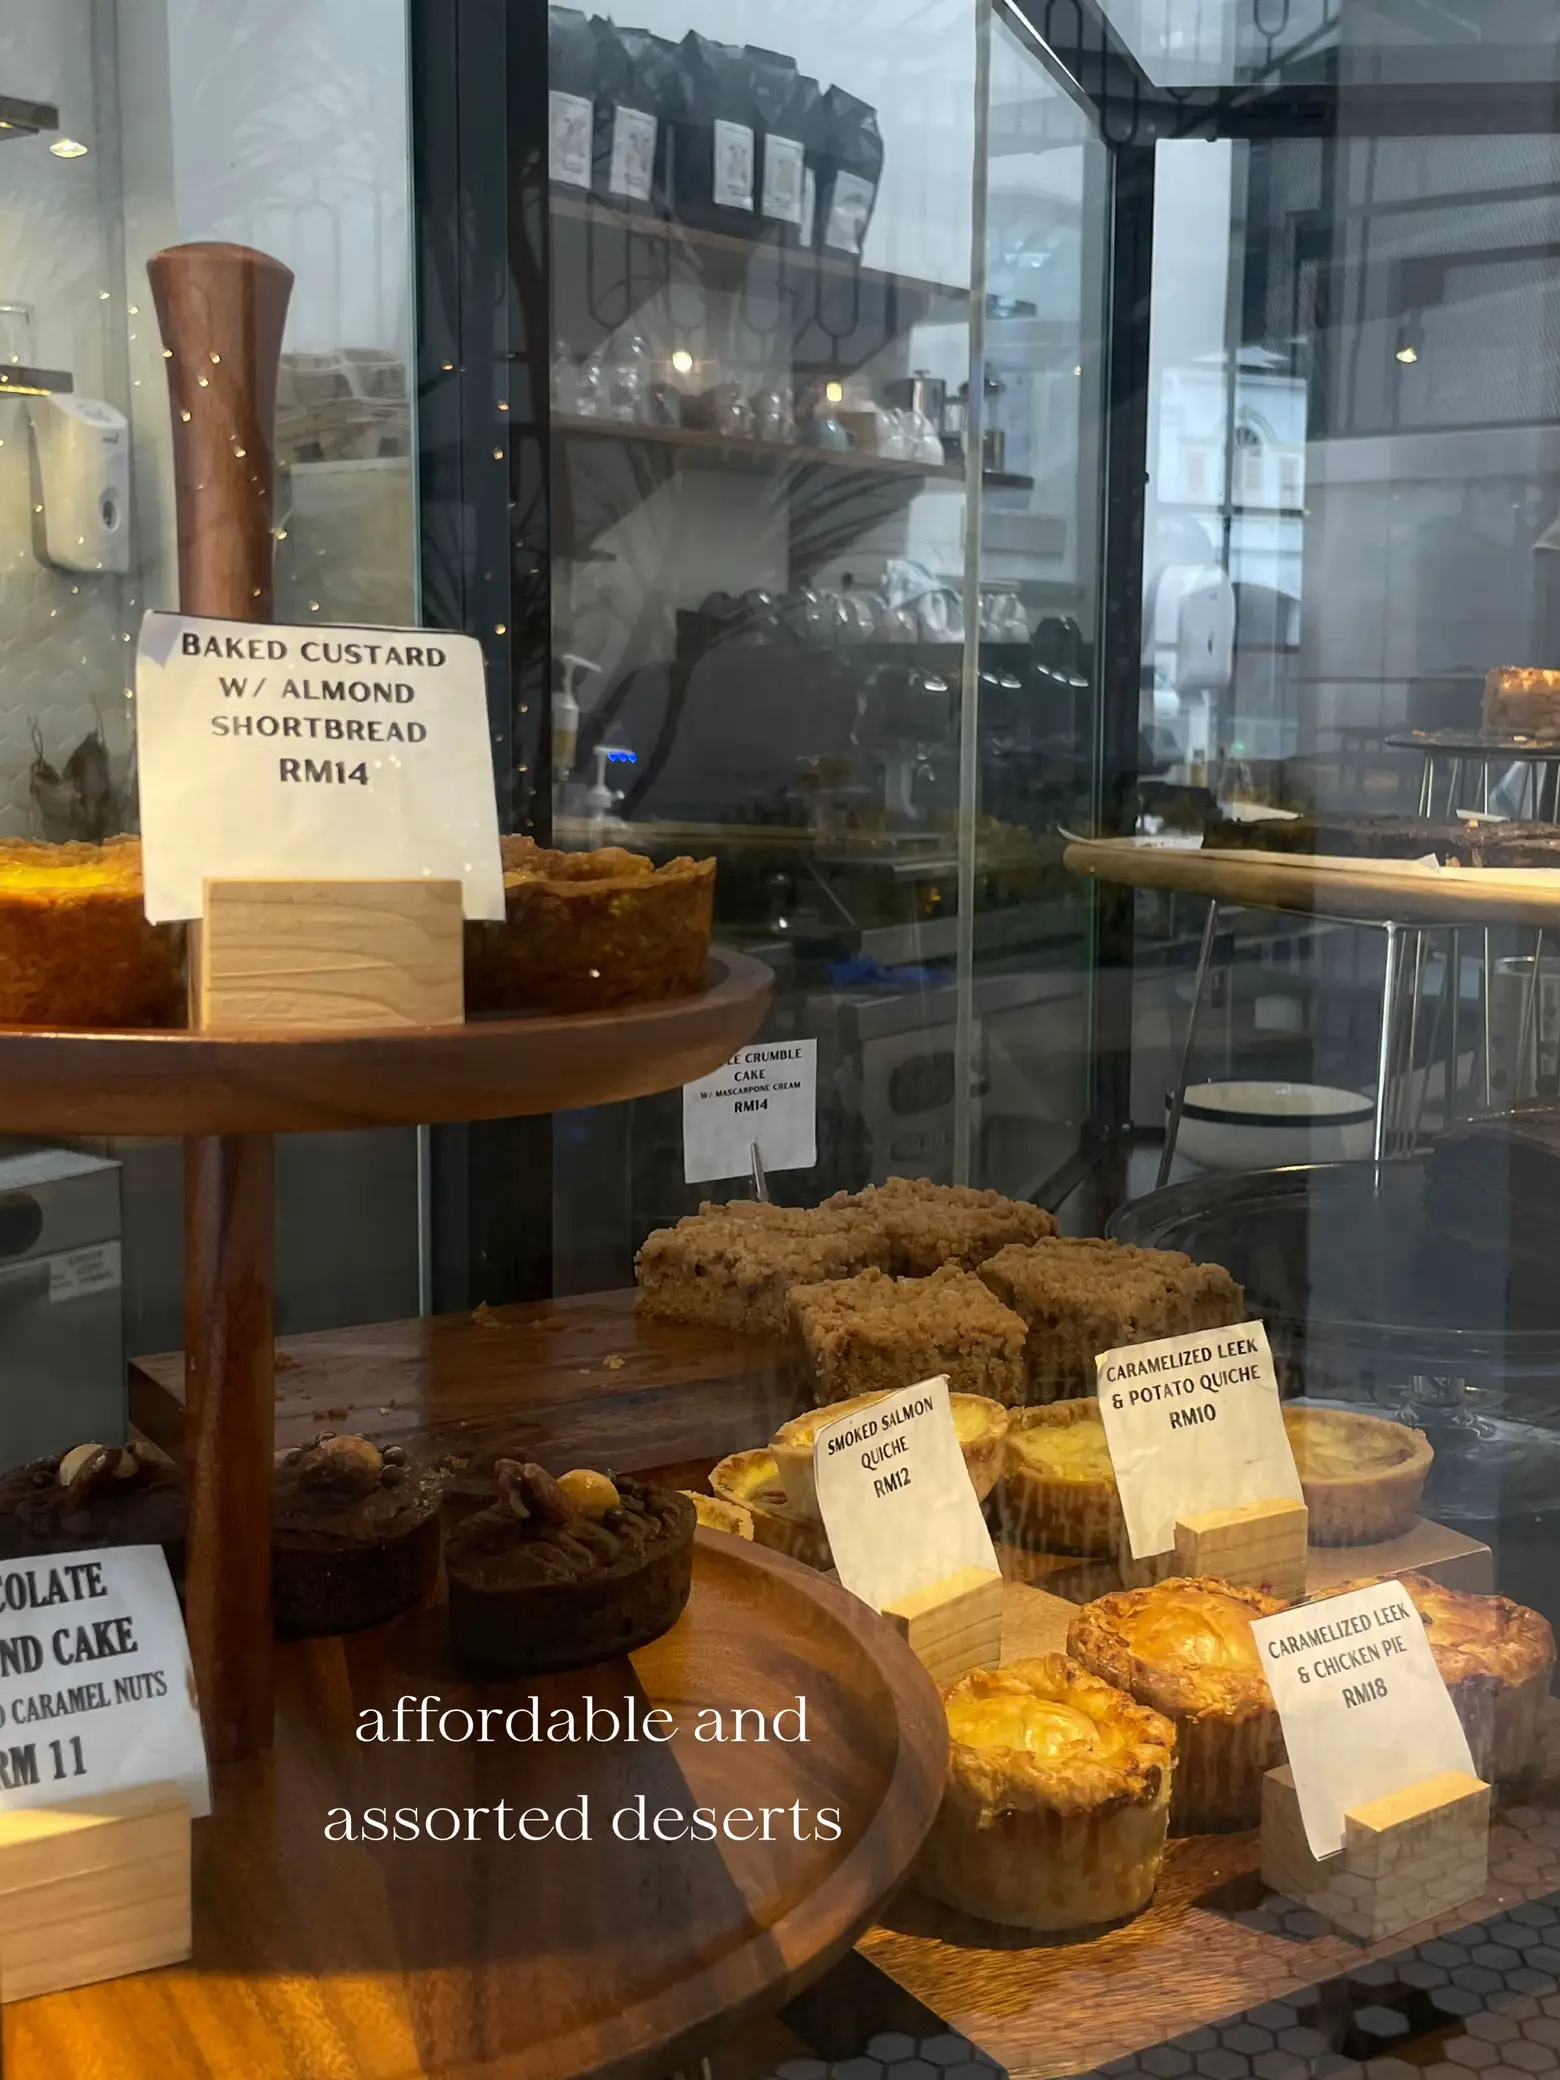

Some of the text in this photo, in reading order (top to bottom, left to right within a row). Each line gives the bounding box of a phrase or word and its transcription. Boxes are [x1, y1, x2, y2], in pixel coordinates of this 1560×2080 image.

[182, 633, 446, 667] BAKED CUSTARD
[219, 677, 415, 704] W/ ALMOND
[211, 716, 427, 743] SHORTBREAD
[279, 758, 369, 785] RM14
[745, 1049, 802, 1064] CRUMBLE
[715, 1085, 770, 1098] MASCARPONE
[773, 1082, 801, 1091] CREAM
[734, 1069, 766, 1082] CAKE
[734, 1099, 768, 1113] RM14
[1106, 1338, 1258, 1382] CARAMELIZED LEEK
[1112, 1365, 1261, 1409] & POTATO QUICHE
[828, 1396, 934, 1456] SMOKED SALMON
[1169, 1403, 1216, 1429] RM10
[861, 1436, 909, 1471] QUICHE
[873, 1467, 911, 1498] RM12
[0, 1562, 108, 1614] OLATE
[0, 1616, 138, 1677] ND CAKE
[1268, 1602, 1410, 1659] CARAMELIZED LEEK
[1297, 1636, 1407, 1684] & CHICKEN PIE
[11, 1682, 112, 1724] CARAMEL
[114, 1671, 168, 1705] NUTS
[1342, 1677, 1388, 1708] RM18
[48, 1736, 87, 1780] 11
